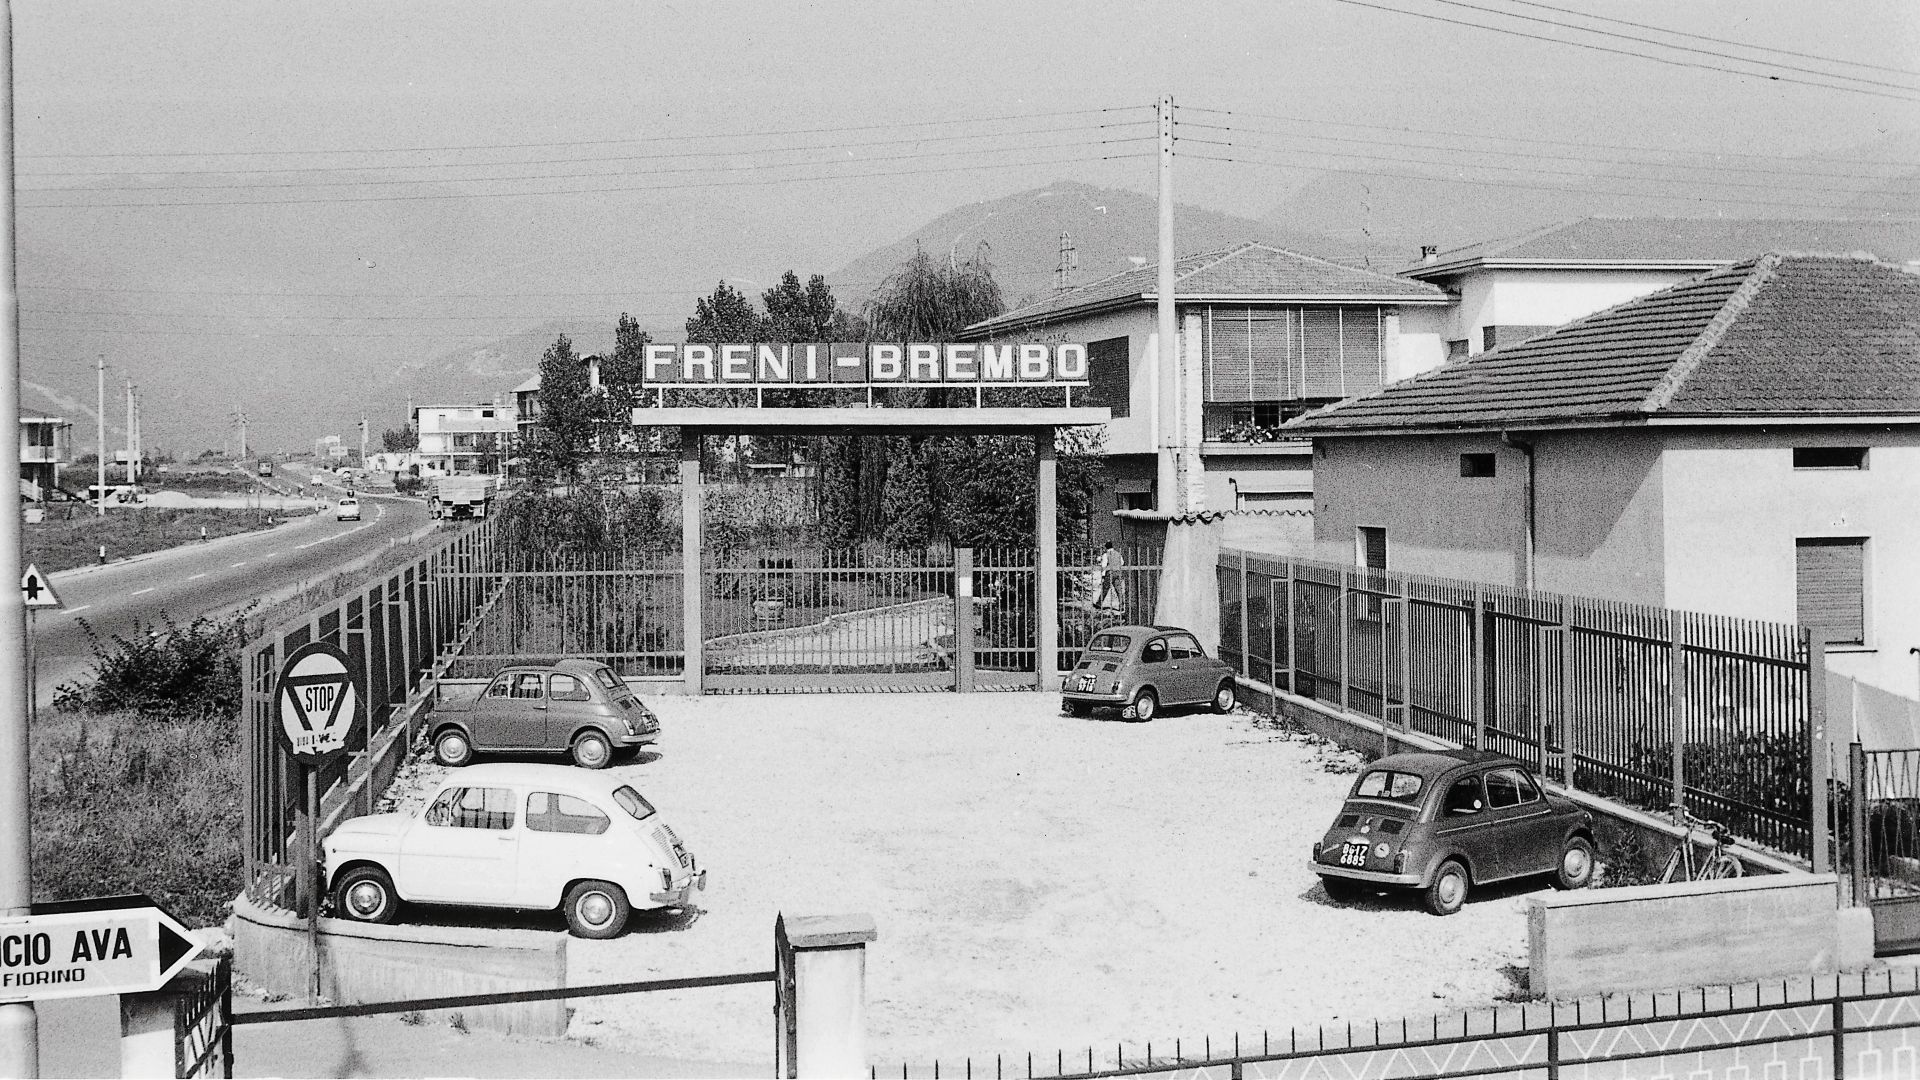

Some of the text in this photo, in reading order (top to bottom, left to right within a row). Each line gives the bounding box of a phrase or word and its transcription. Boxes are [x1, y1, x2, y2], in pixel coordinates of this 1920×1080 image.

[306, 686, 334, 711] STOP
[1340, 854, 1365, 866] 6885
[0, 928, 132, 967] CIO AVA
[4, 968, 85, 987] FIORINO
